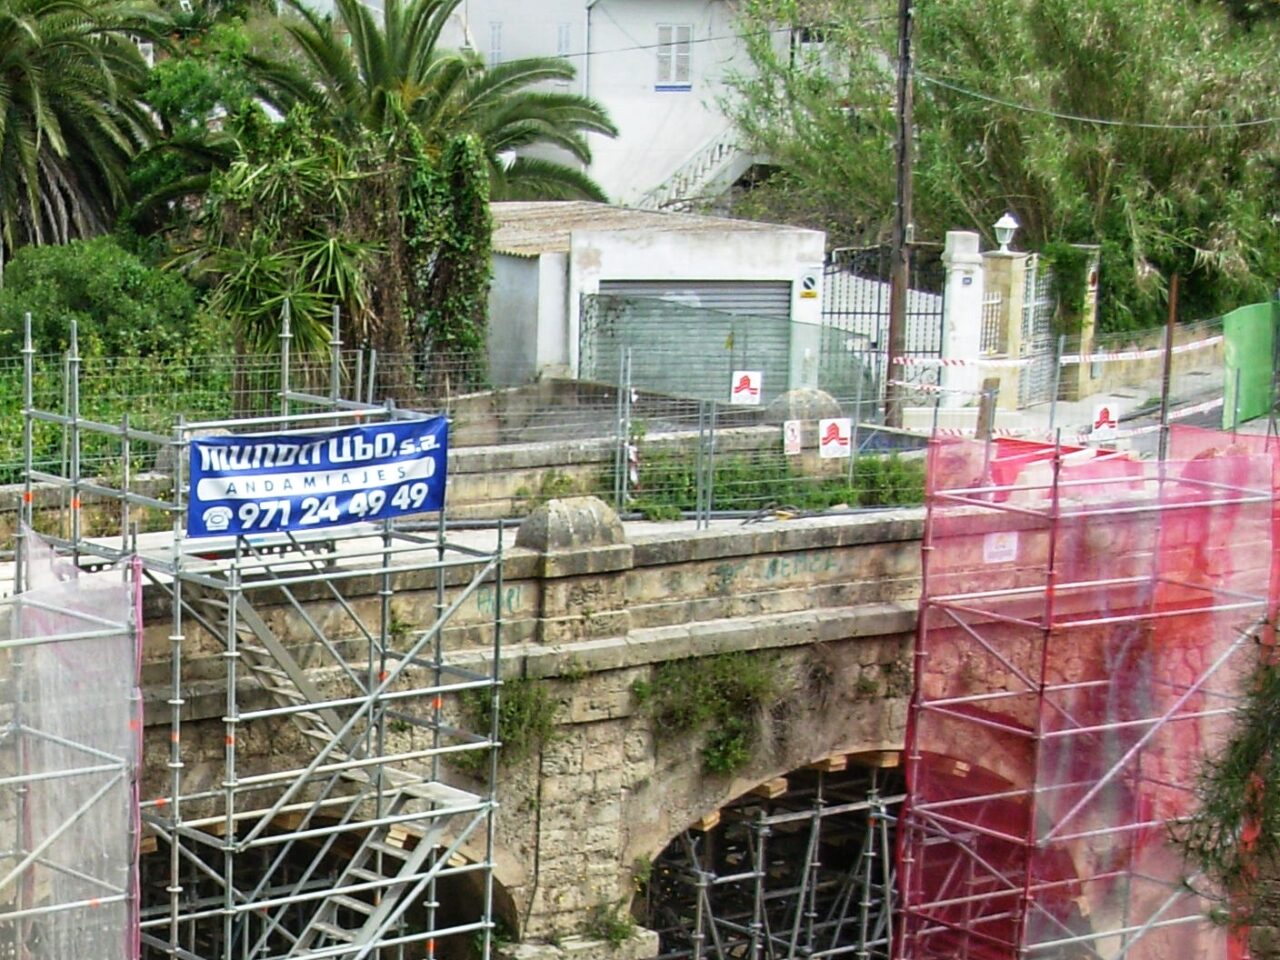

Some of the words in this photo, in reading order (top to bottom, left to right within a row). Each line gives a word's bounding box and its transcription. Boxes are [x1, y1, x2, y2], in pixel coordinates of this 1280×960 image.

[225, 466, 407, 496] ANDAMIAJES
[238, 500, 291, 529] 971
[299, 495, 341, 525] 24
[348, 489, 386, 517] 49
[391, 482, 429, 510] 49
